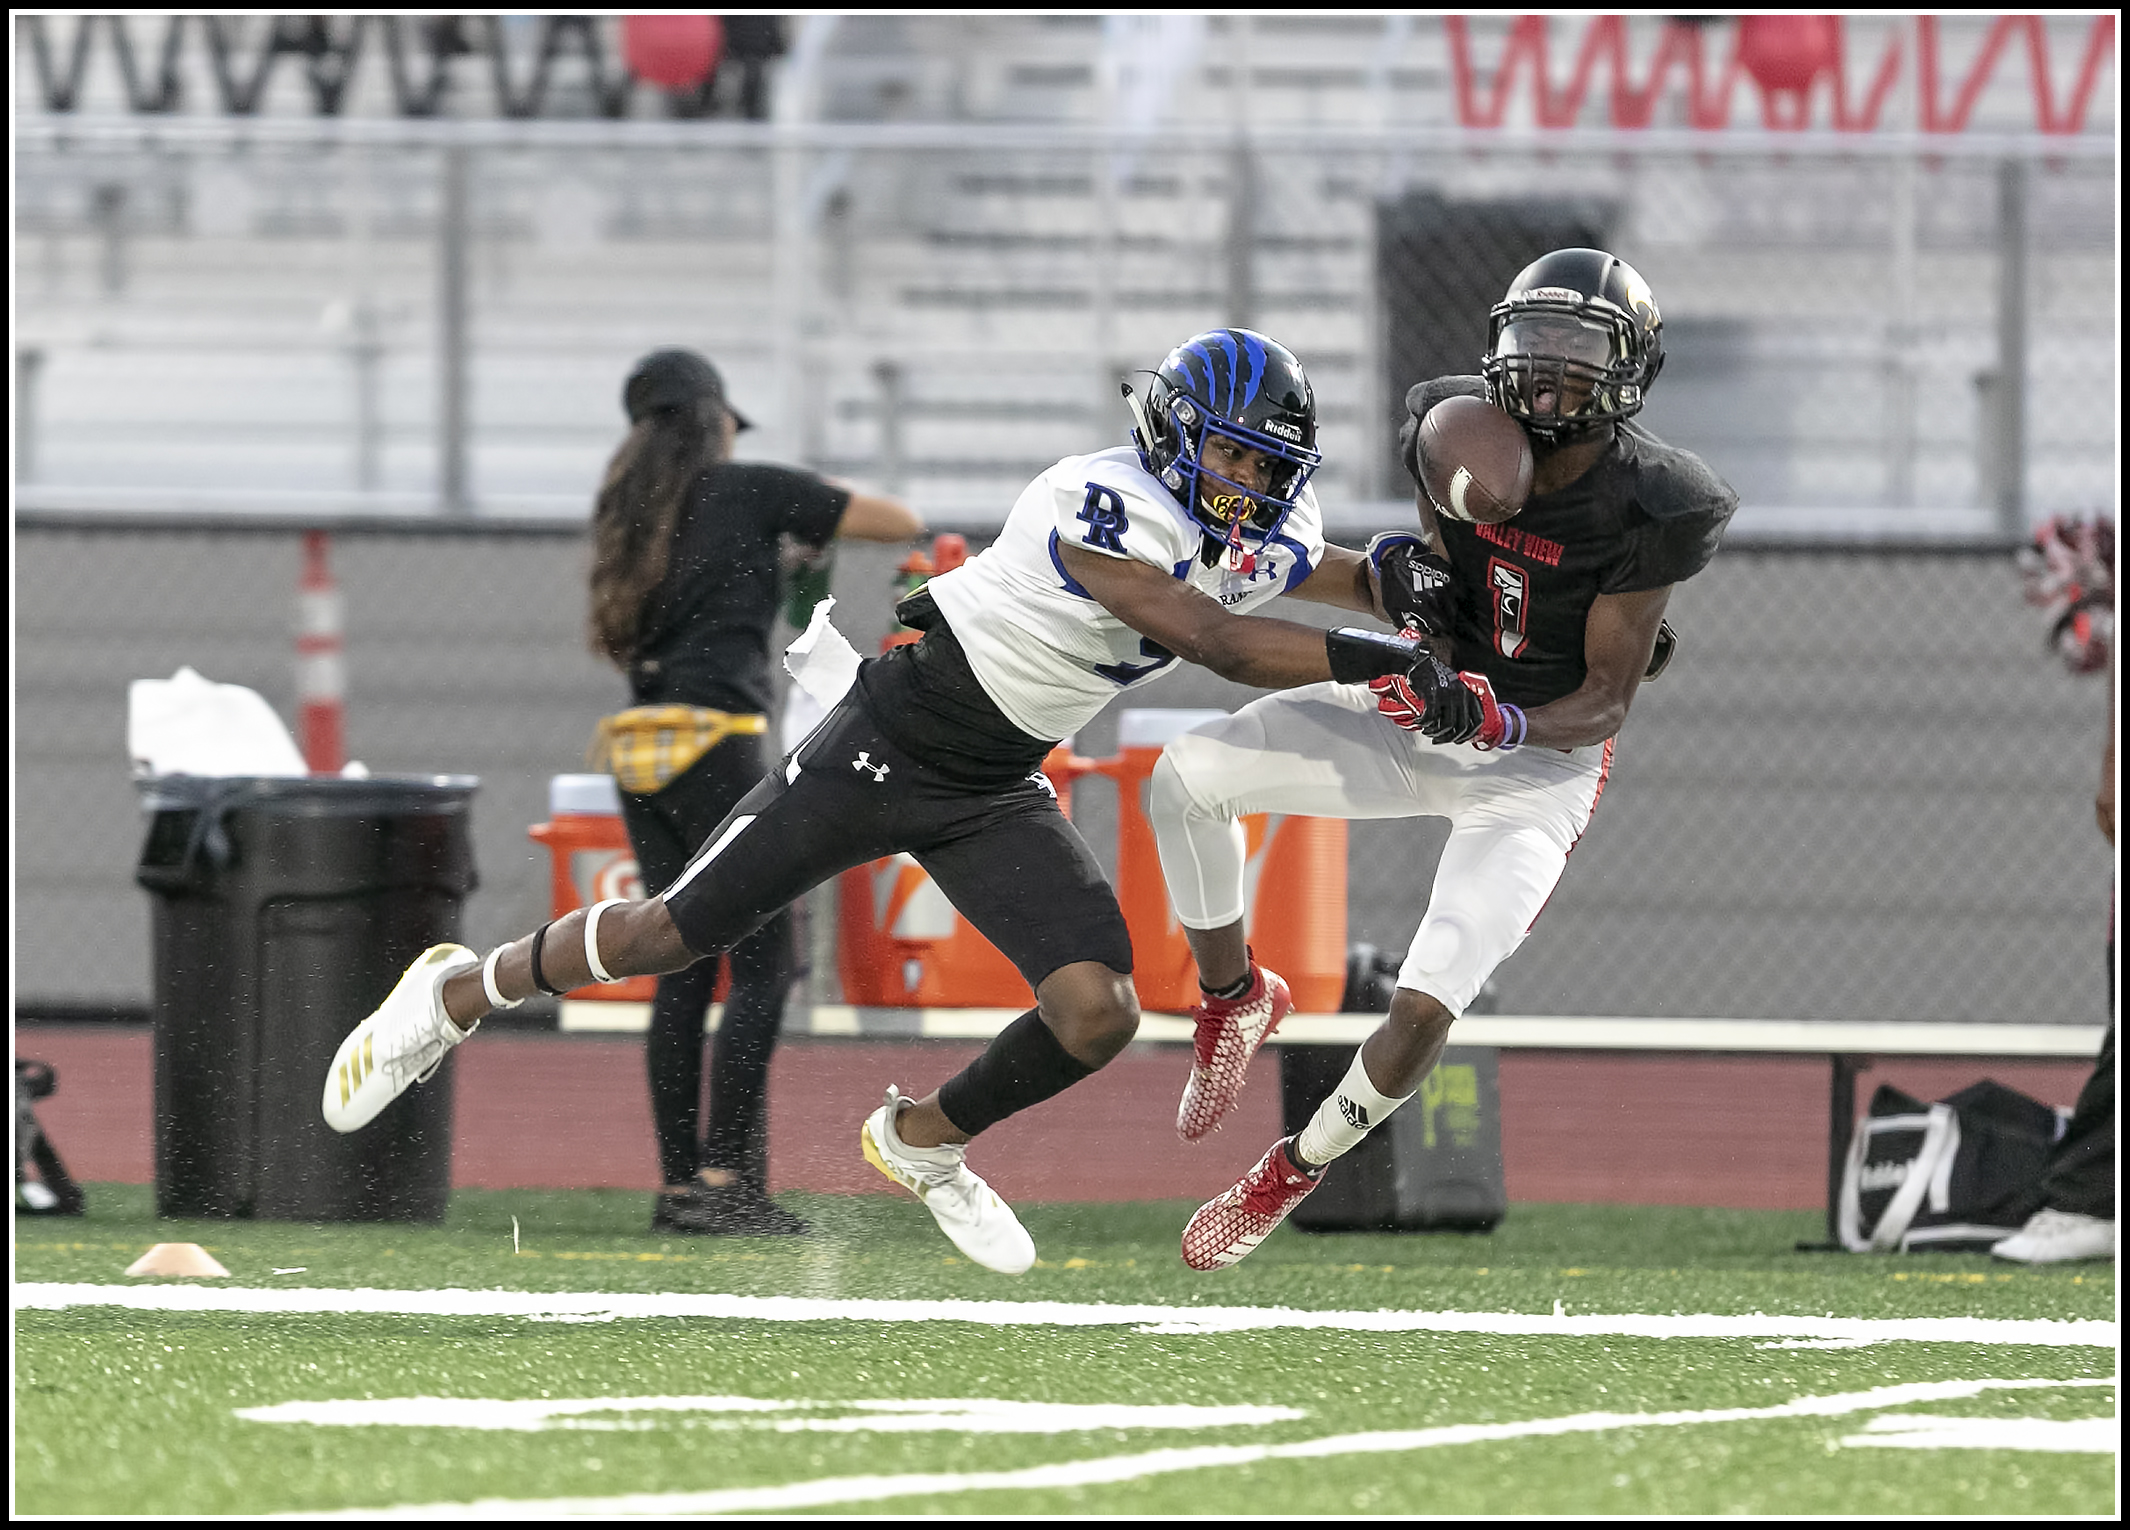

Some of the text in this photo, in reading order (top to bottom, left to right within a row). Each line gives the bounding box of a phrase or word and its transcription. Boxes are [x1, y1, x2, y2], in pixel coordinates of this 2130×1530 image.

[1264, 418, 1302, 443] Riddell
[1076, 481, 1129, 556] DR
[1475, 521, 1565, 567] VALLEY VIEW
[1407, 559, 1451, 584] adidas
[1486, 555, 1530, 659] 1
